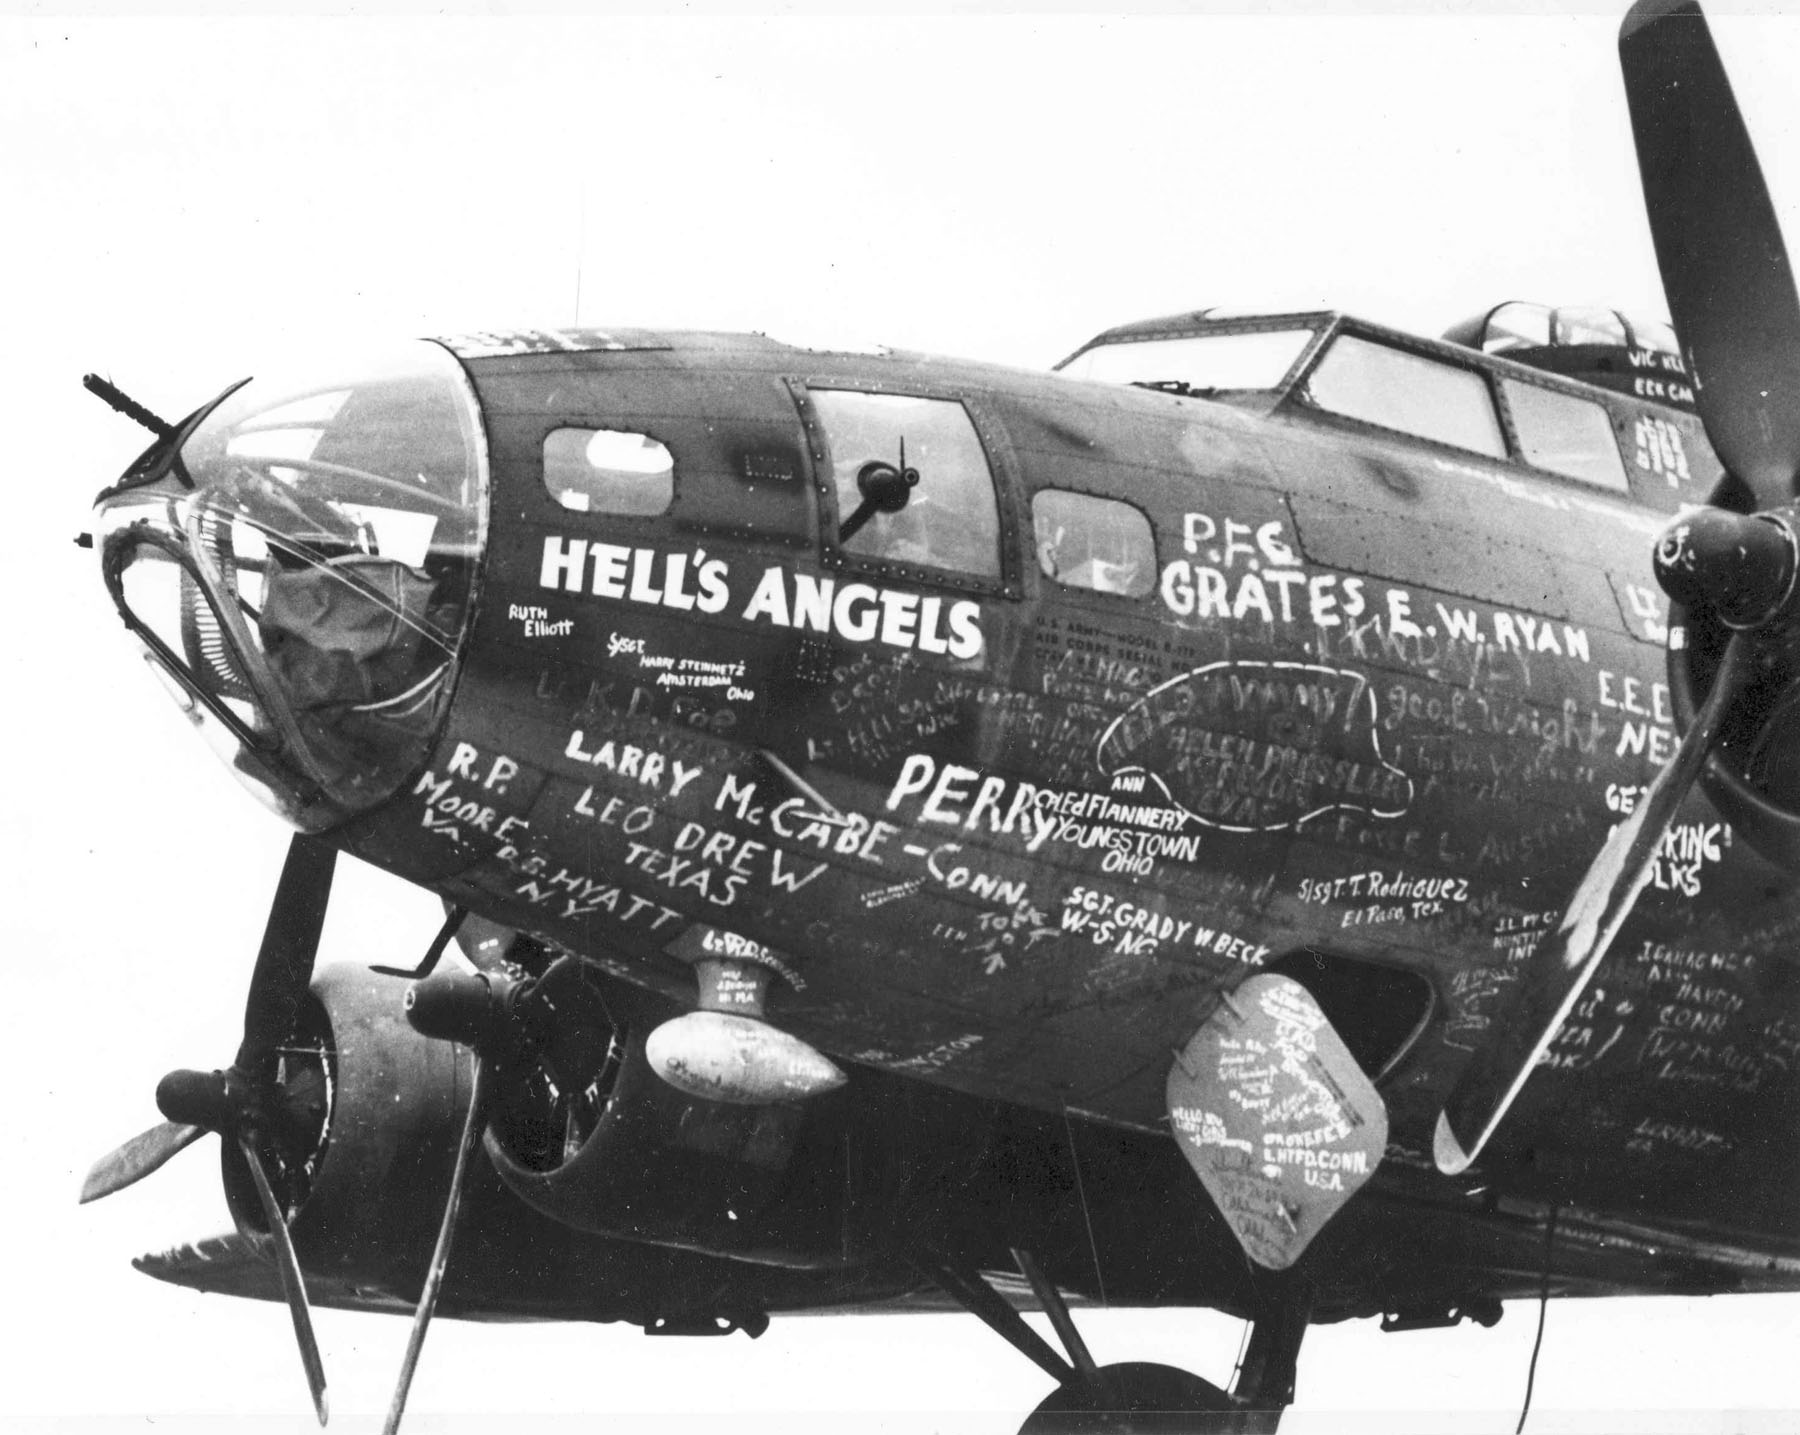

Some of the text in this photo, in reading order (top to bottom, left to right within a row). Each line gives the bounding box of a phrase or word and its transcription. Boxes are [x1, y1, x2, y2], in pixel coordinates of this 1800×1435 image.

[509, 604, 547, 620] RUTH
[525, 620, 574, 637] Elliott
[540, 536, 985, 659] HELL'S ANGELS
[1161, 560, 1365, 626] GRATES
[1494, 611, 1590, 663] RYAN
[565, 729, 703, 797] LARRY
[1615, 722, 1683, 766] NE
[413, 771, 529, 840] MOORE
[1110, 775, 1146, 792] ANN
[574, 786, 829, 892] LEO DREW
[548, 868, 683, 929] HYATT
[625, 842, 748, 905] TEXAS
[1113, 902, 1193, 943] GRADY
